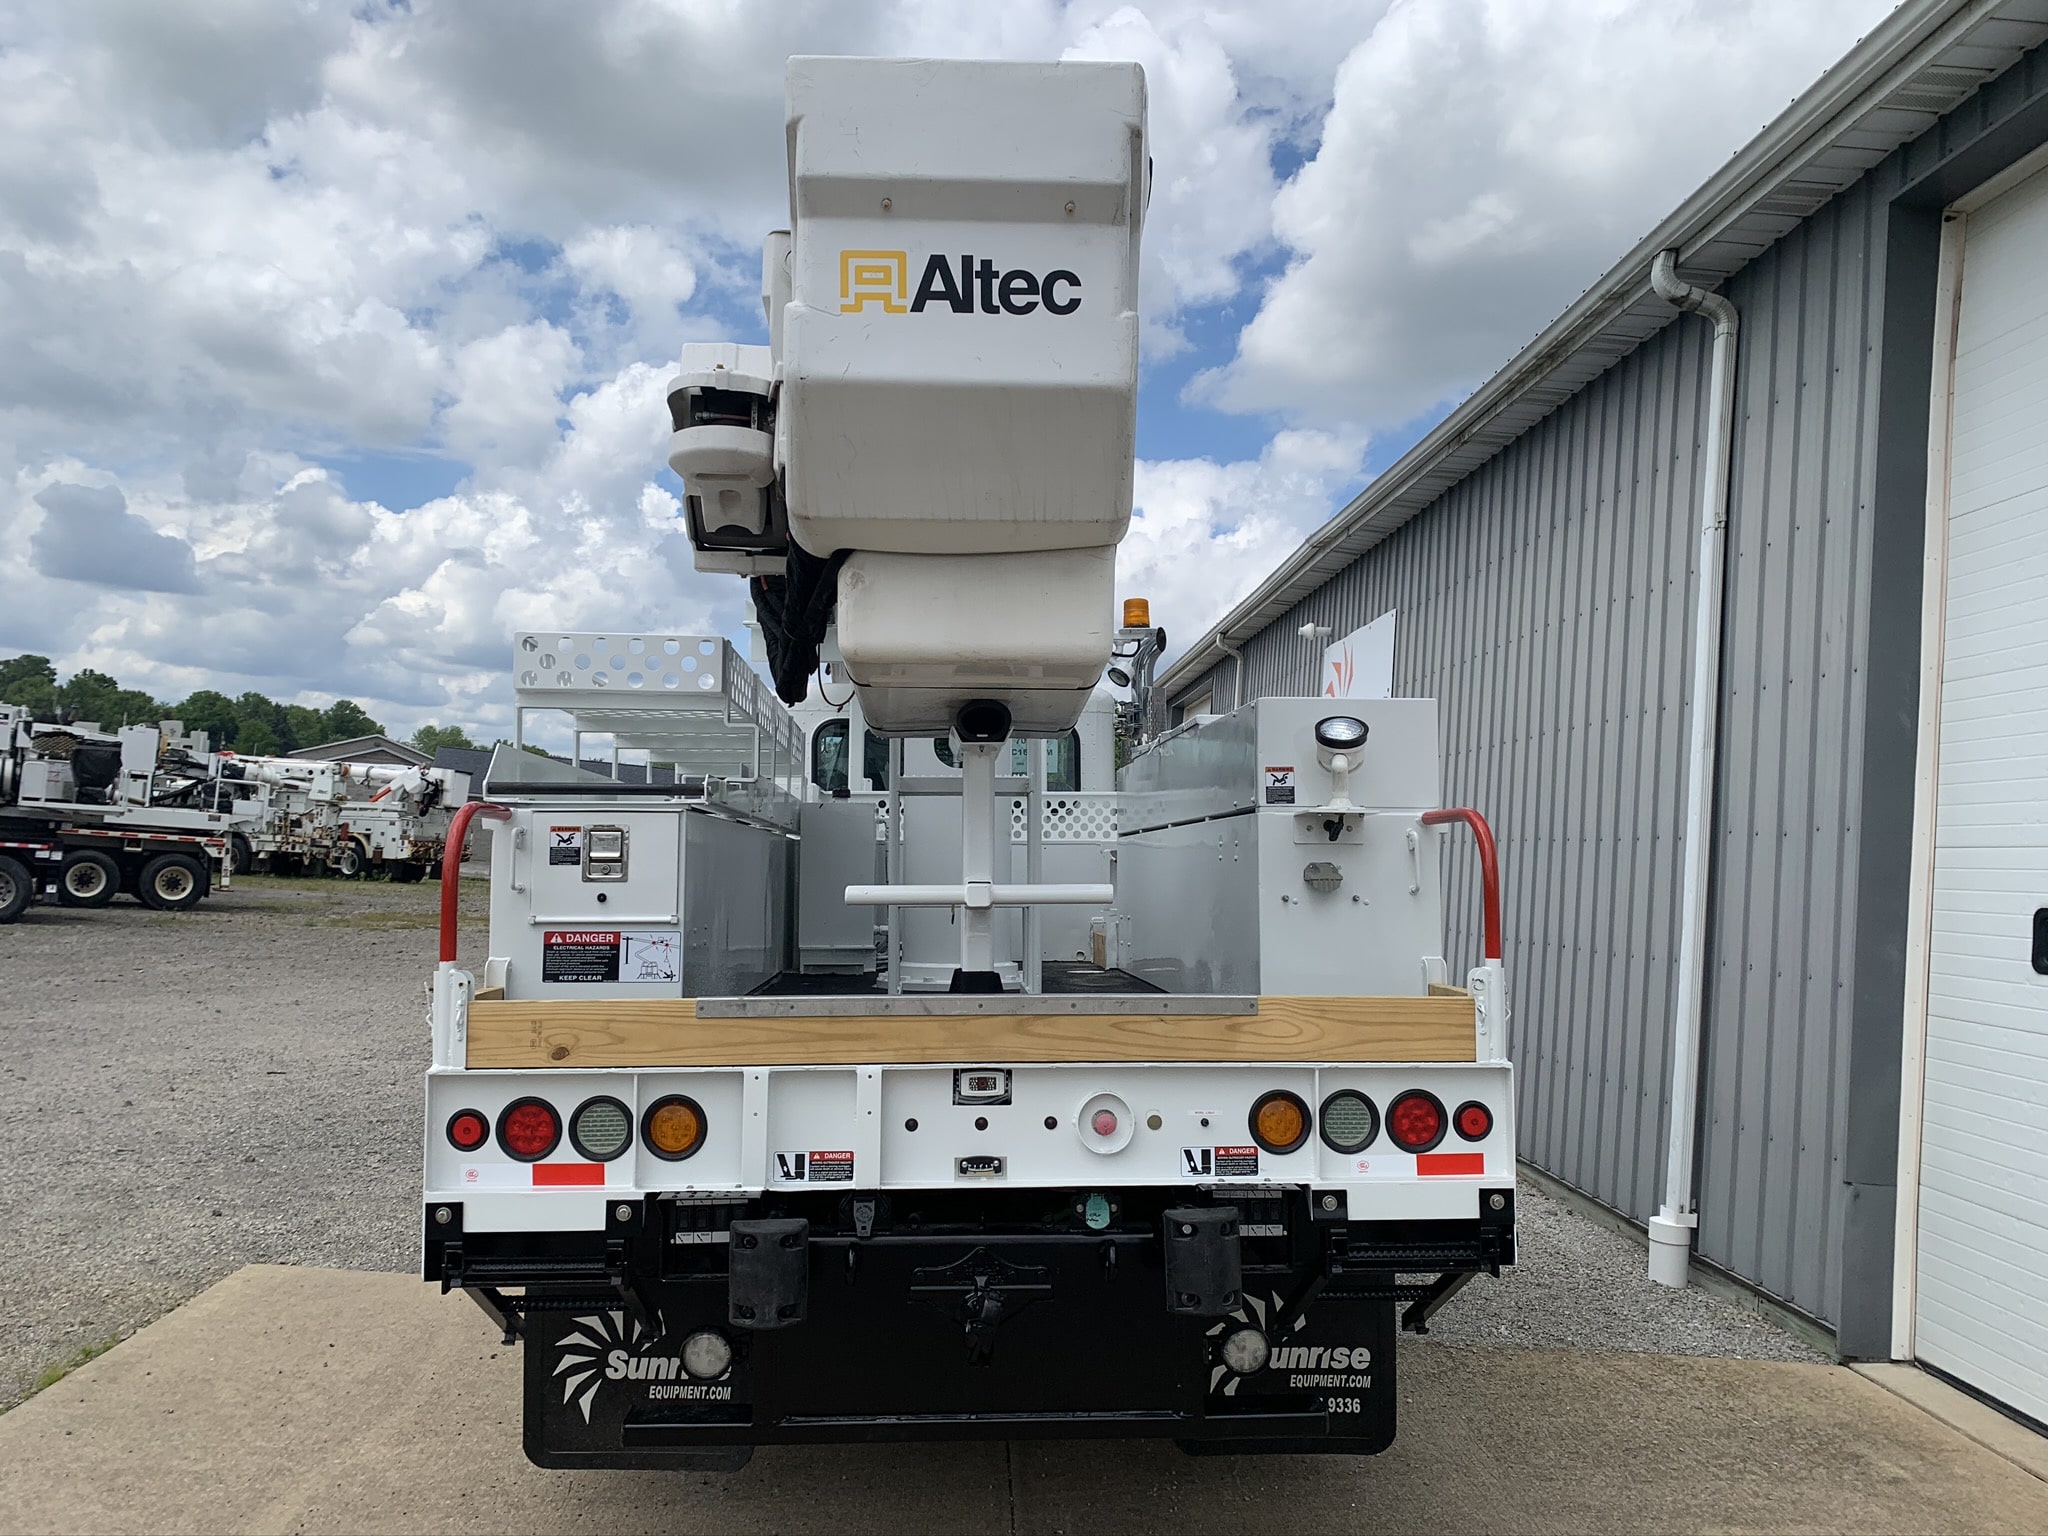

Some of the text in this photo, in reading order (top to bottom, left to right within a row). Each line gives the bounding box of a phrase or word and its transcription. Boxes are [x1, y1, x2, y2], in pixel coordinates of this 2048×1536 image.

[909, 254, 1082, 316] Altec
[566, 933, 614, 943] DANGER
[1269, 1346, 1371, 1370] unrise
[1290, 1374, 1371, 1389] EQUIPMENT.COM
[649, 1385, 732, 1400] EQUIPMENT.COM
[1327, 1397, 1361, 1413] 9336
